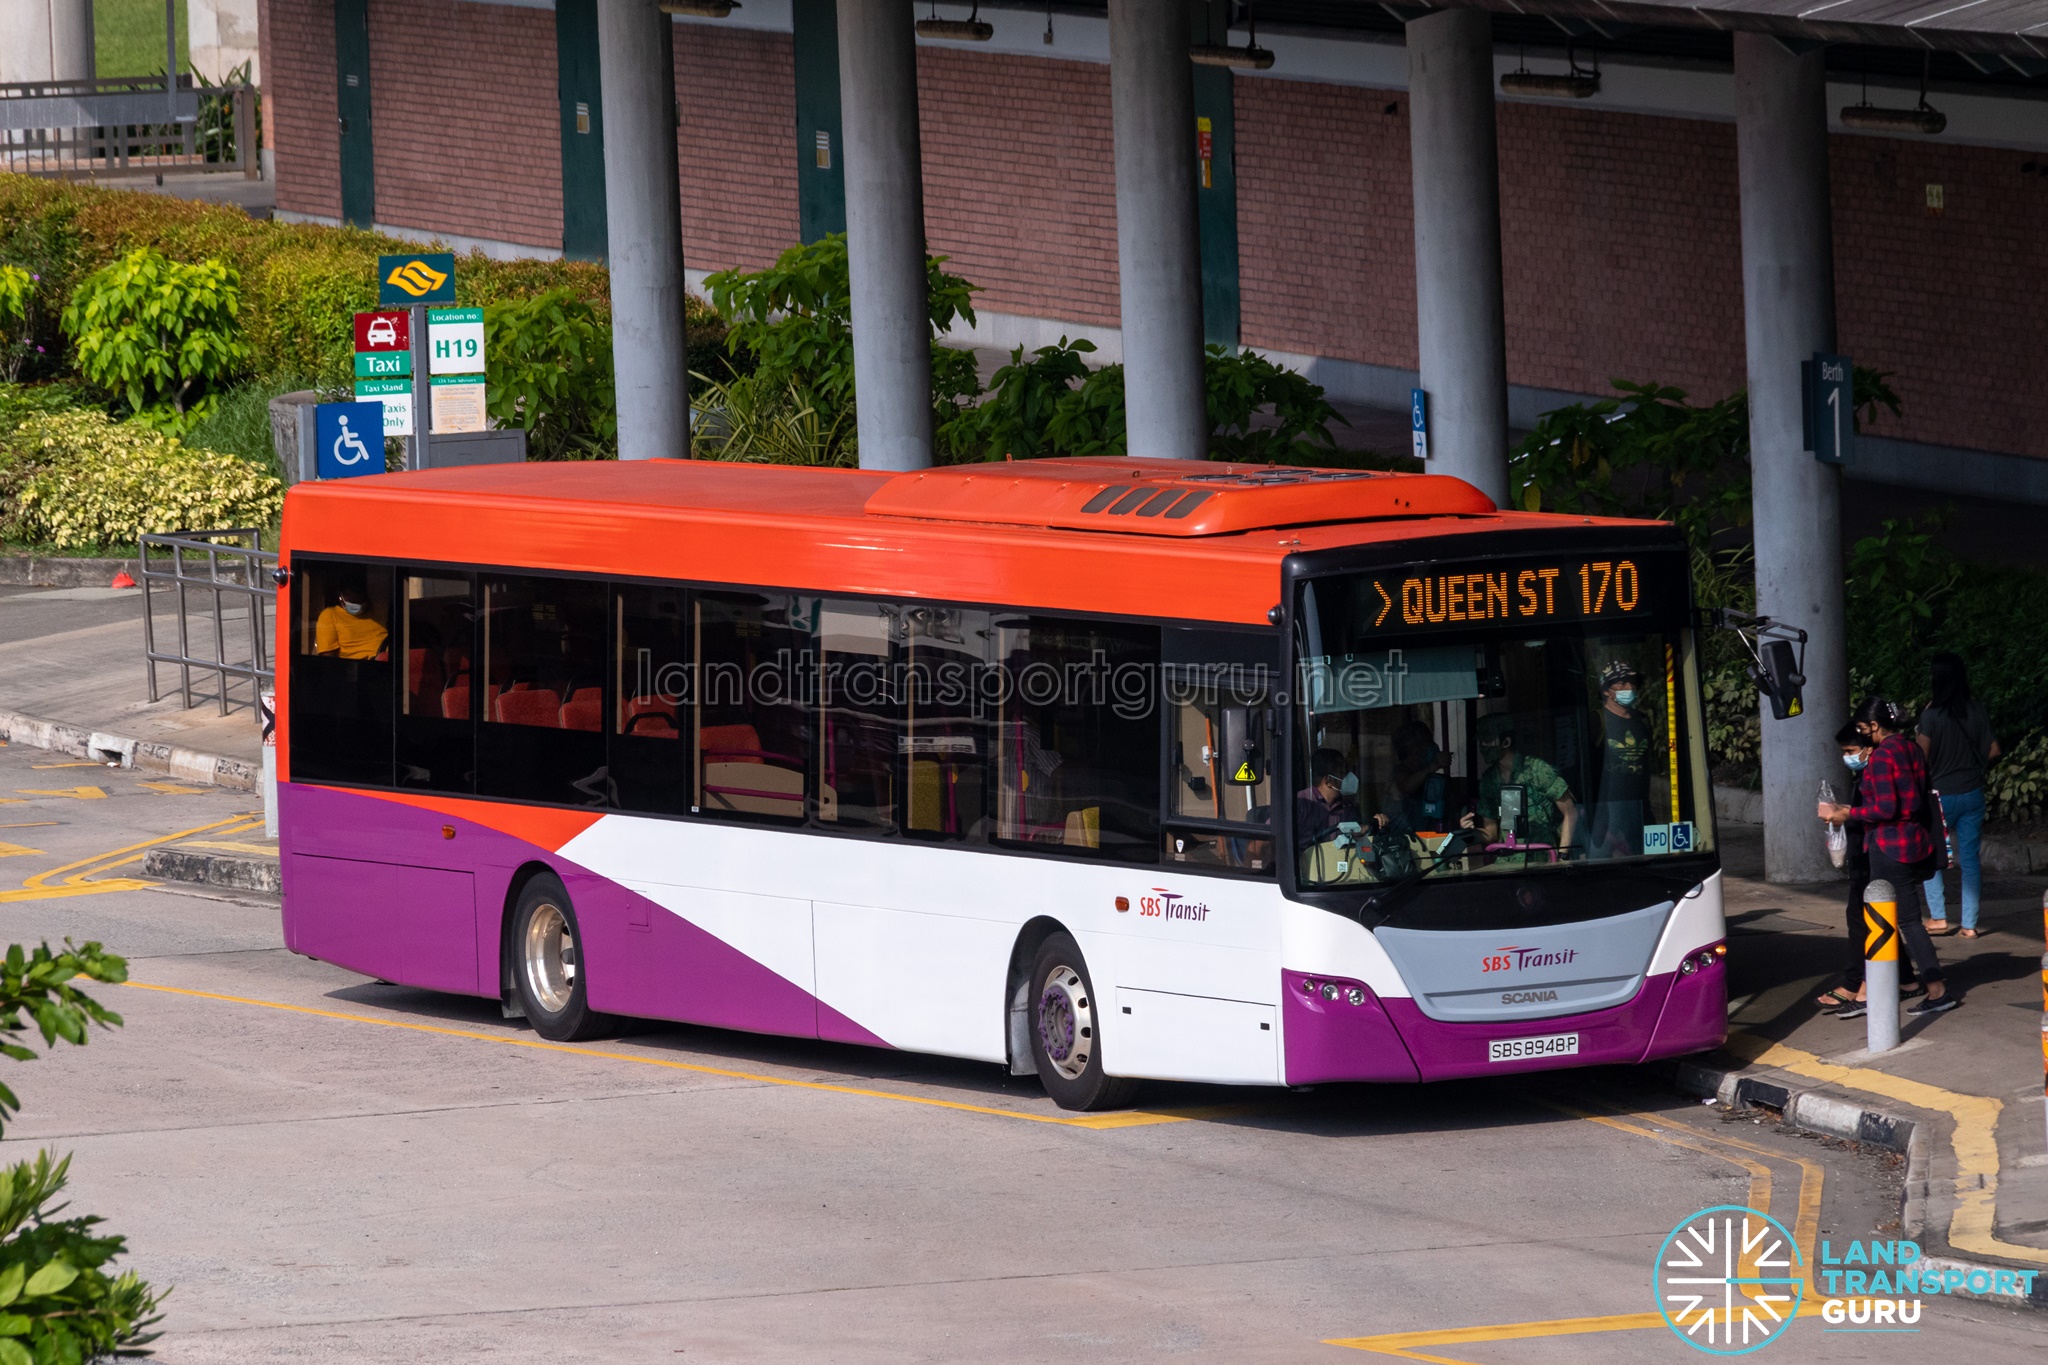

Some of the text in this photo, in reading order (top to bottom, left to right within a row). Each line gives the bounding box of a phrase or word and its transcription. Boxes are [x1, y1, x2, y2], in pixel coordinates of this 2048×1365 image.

[432, 313, 464, 322] Location
[436, 338, 478, 358] H19
[365, 355, 401, 373] Taxi
[1822, 361, 1844, 382] Berth
[381, 383, 403, 391] Stand
[382, 403, 407, 413] Taxis
[382, 417, 405, 428] Only
[1827, 387, 1841, 457] 1
[1402, 560, 1639, 624] QUEEN ST 170
[1645, 832, 1667, 847] UPD
[1140, 893, 1211, 922] SBS Transit
[1482, 947, 1579, 973] SBS Transit
[1501, 990, 1559, 1005] SCANIA
[1492, 1036, 1577, 1059] SBS8948P
